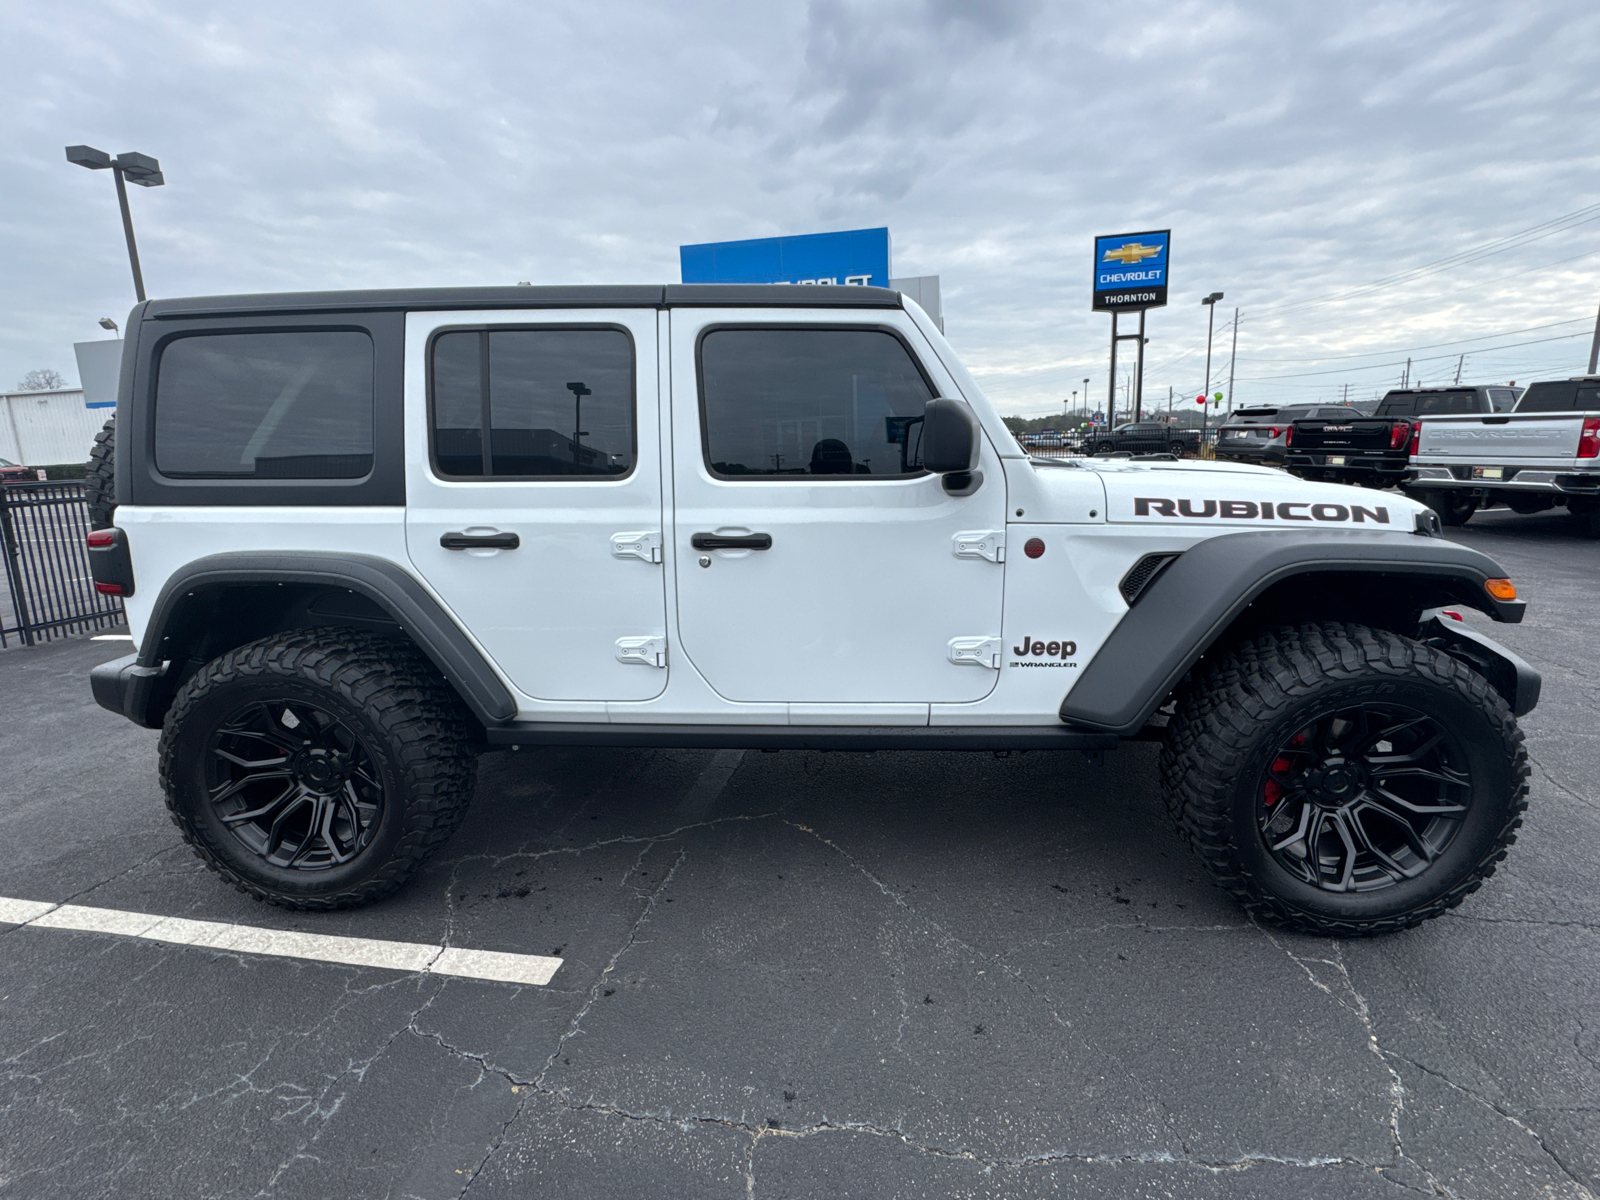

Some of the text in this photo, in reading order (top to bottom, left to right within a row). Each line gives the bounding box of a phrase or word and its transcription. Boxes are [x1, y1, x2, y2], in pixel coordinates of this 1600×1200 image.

[1100, 270, 1162, 283] CHEVROLET
[1104, 292, 1156, 304] THORNTON
[1427, 429, 1569, 439] CHEVROLET
[1133, 497, 1391, 525] RUBICON
[1013, 636, 1077, 660] Jeep
